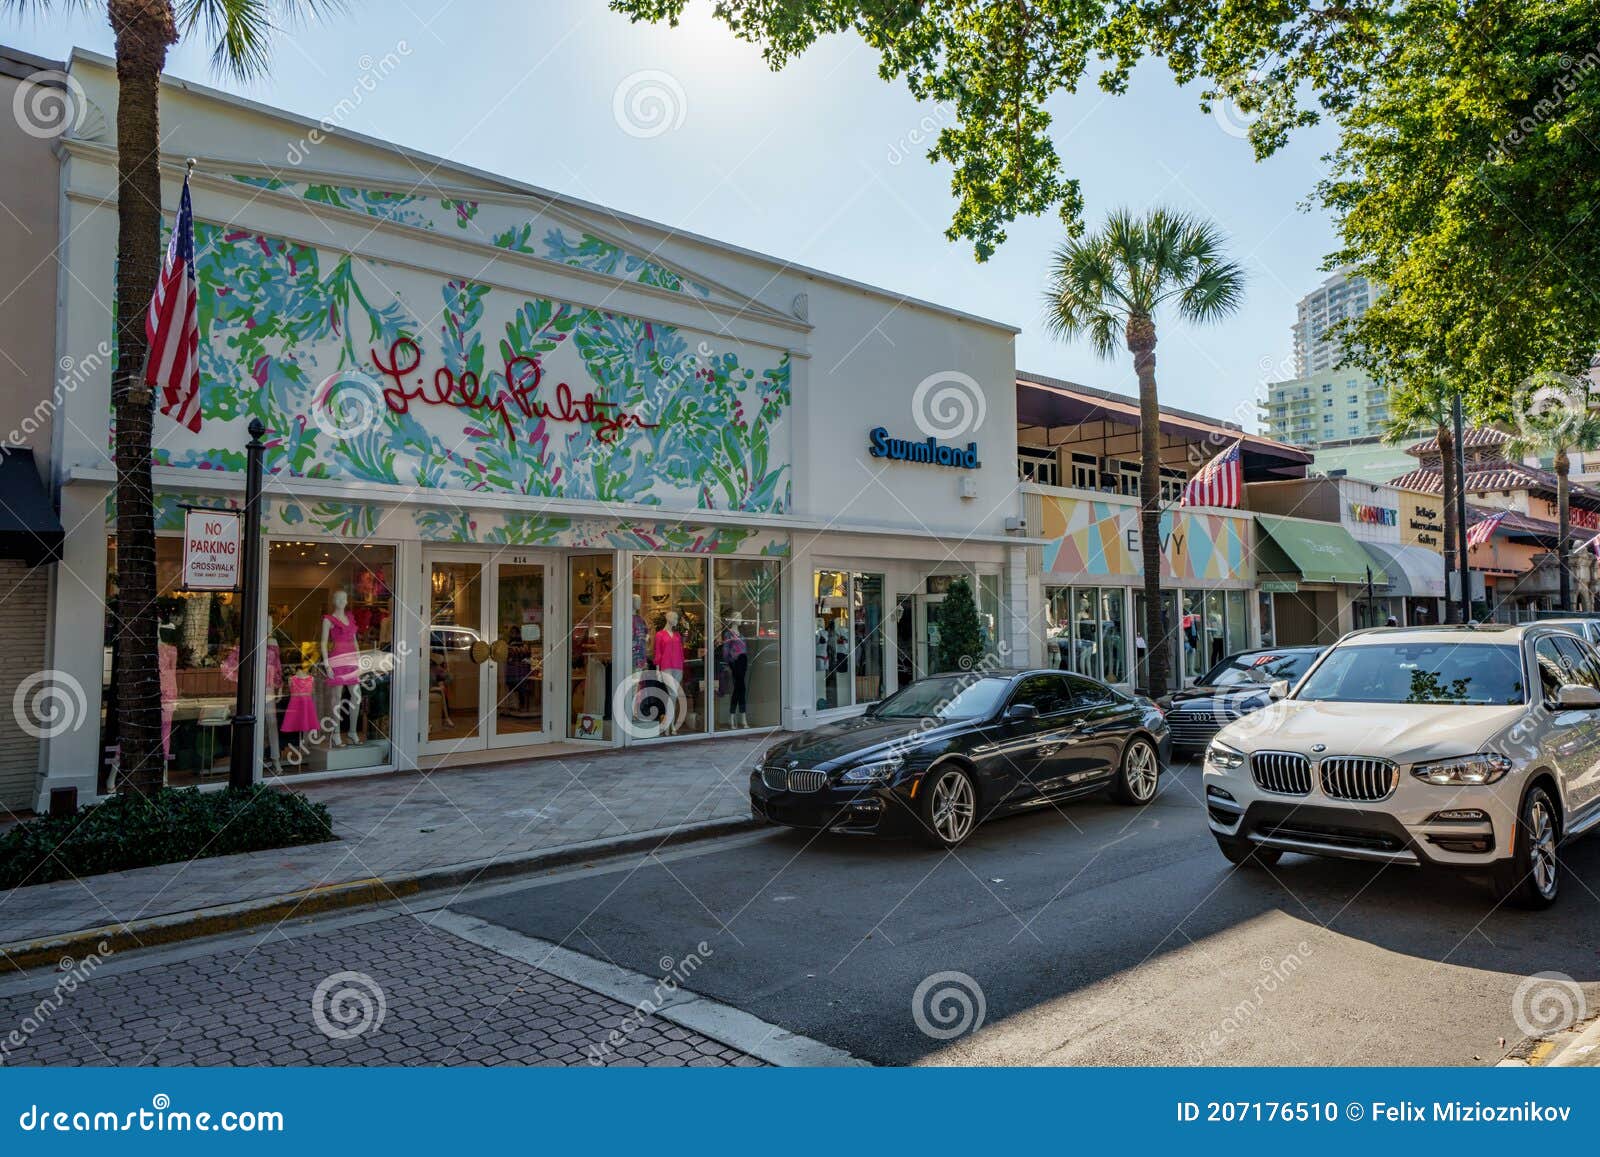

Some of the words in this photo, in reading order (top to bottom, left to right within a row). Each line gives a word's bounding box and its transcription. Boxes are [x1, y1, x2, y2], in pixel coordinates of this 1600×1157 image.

[371, 338, 516, 441] Lilly
[506, 356, 660, 442] Pulitzer
[205, 522, 222, 536] NO
[190, 540, 236, 555] PARKING
[1127, 529, 1184, 555] EVY
[191, 562, 235, 572] CROSSWALK
